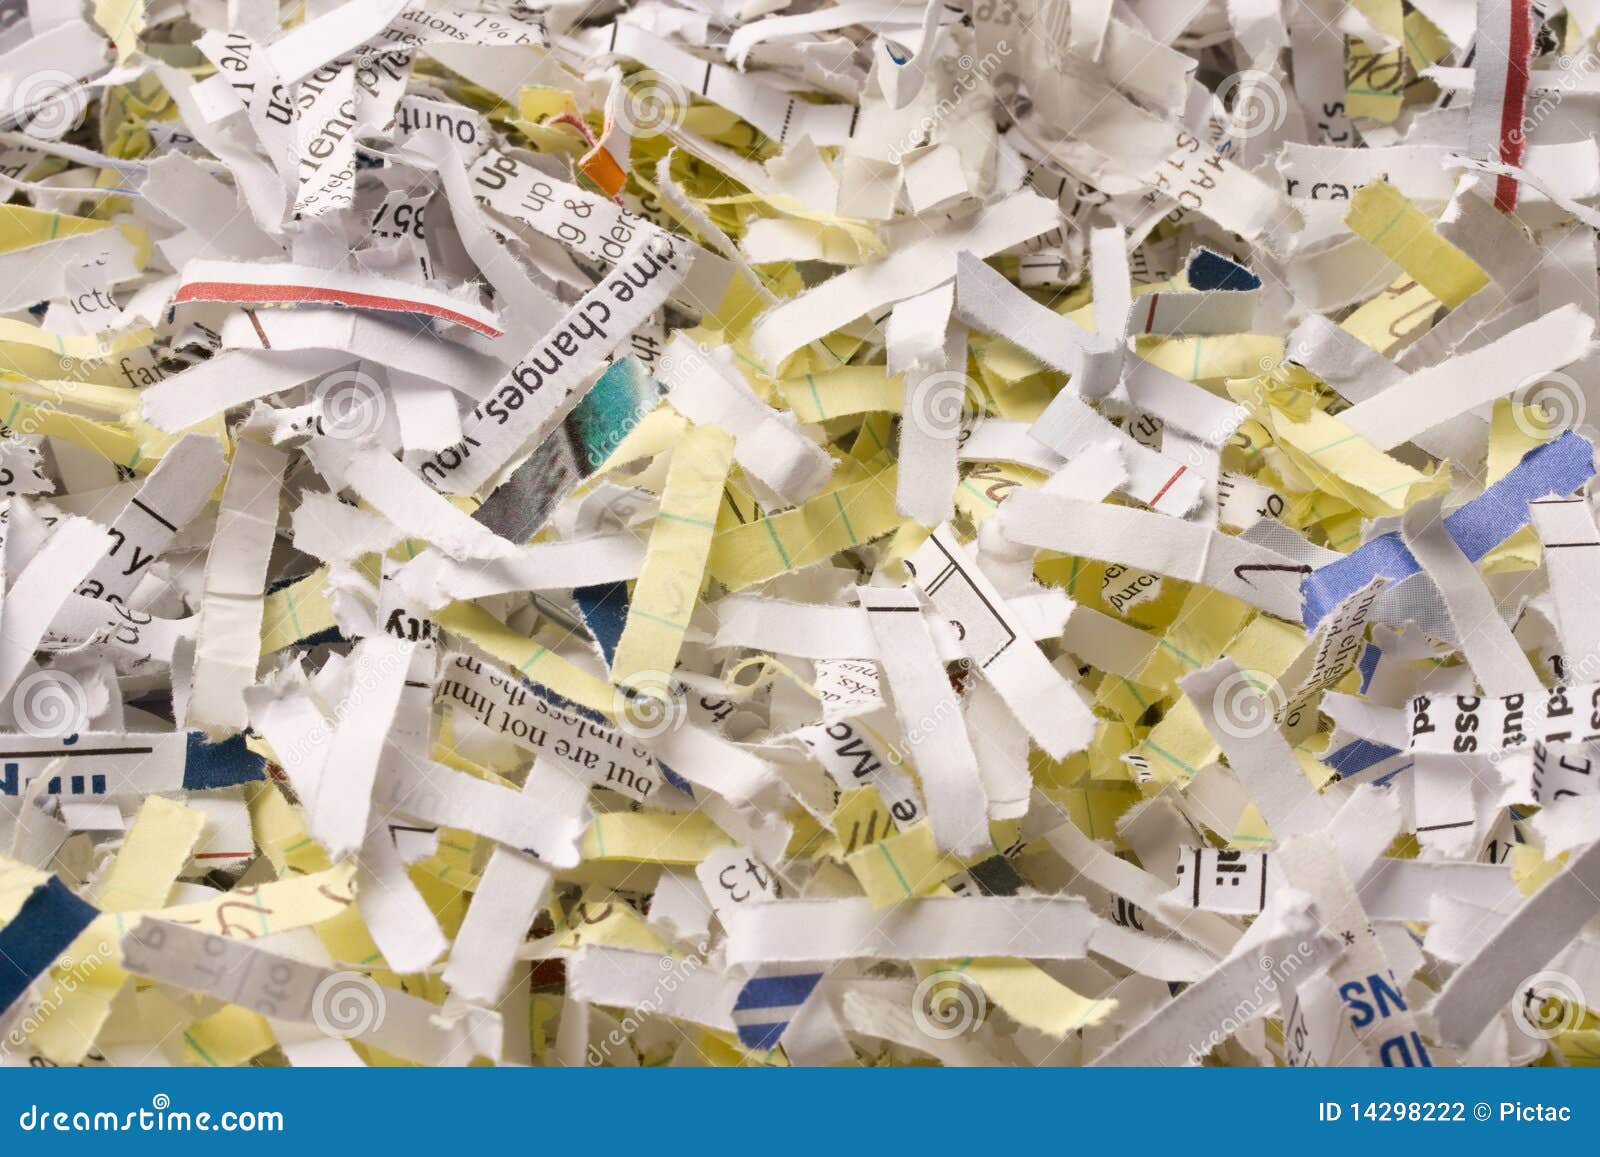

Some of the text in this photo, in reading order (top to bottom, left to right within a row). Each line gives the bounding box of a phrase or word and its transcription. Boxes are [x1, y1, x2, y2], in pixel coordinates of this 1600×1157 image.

[474, 155, 519, 190] Up
[521, 181, 553, 212] up
[563, 198, 595, 219] &
[474, 303, 611, 425] changes,
[498, 710, 550, 748] not
[554, 737, 600, 770] are
[605, 759, 654, 798] but
